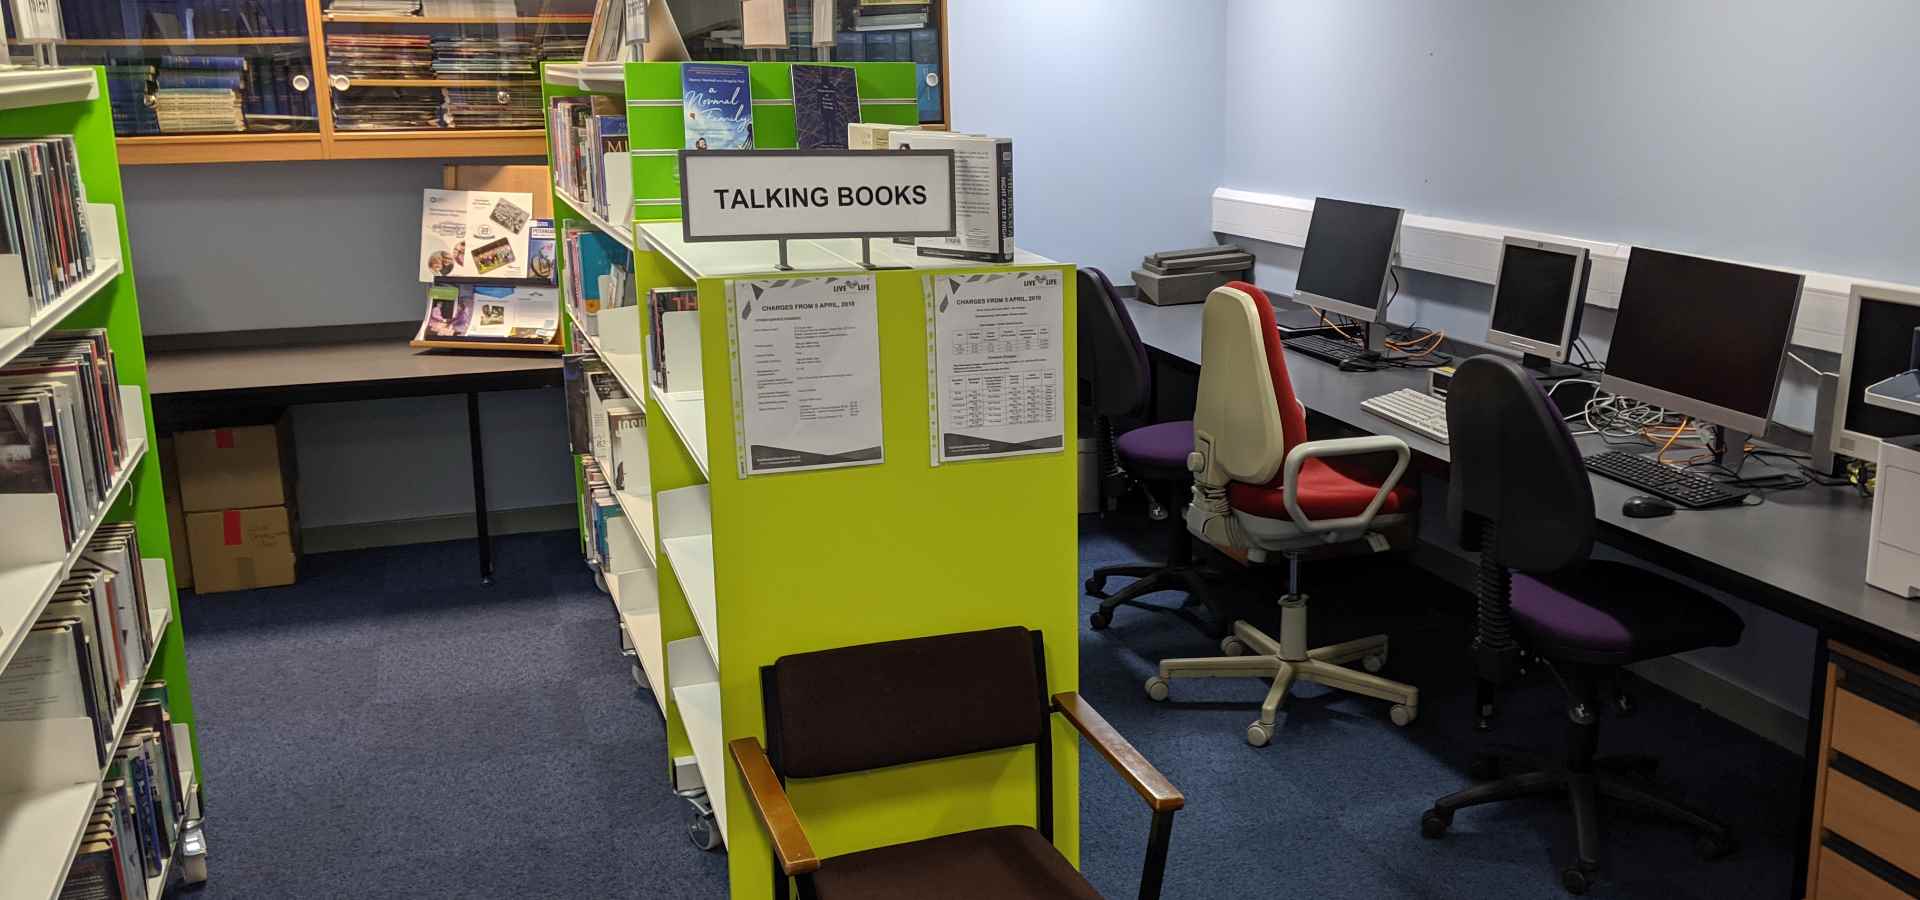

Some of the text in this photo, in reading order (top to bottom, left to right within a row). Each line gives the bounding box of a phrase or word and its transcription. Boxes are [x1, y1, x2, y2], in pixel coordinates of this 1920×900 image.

[686, 86, 740, 106] Normal
[701, 104, 749, 132] Family
[713, 184, 928, 210] TALKING BOOKS
[833, 285, 847, 293] LIVE
[761, 304, 793, 312] CHARGES
[956, 297, 985, 305] CHARGES
